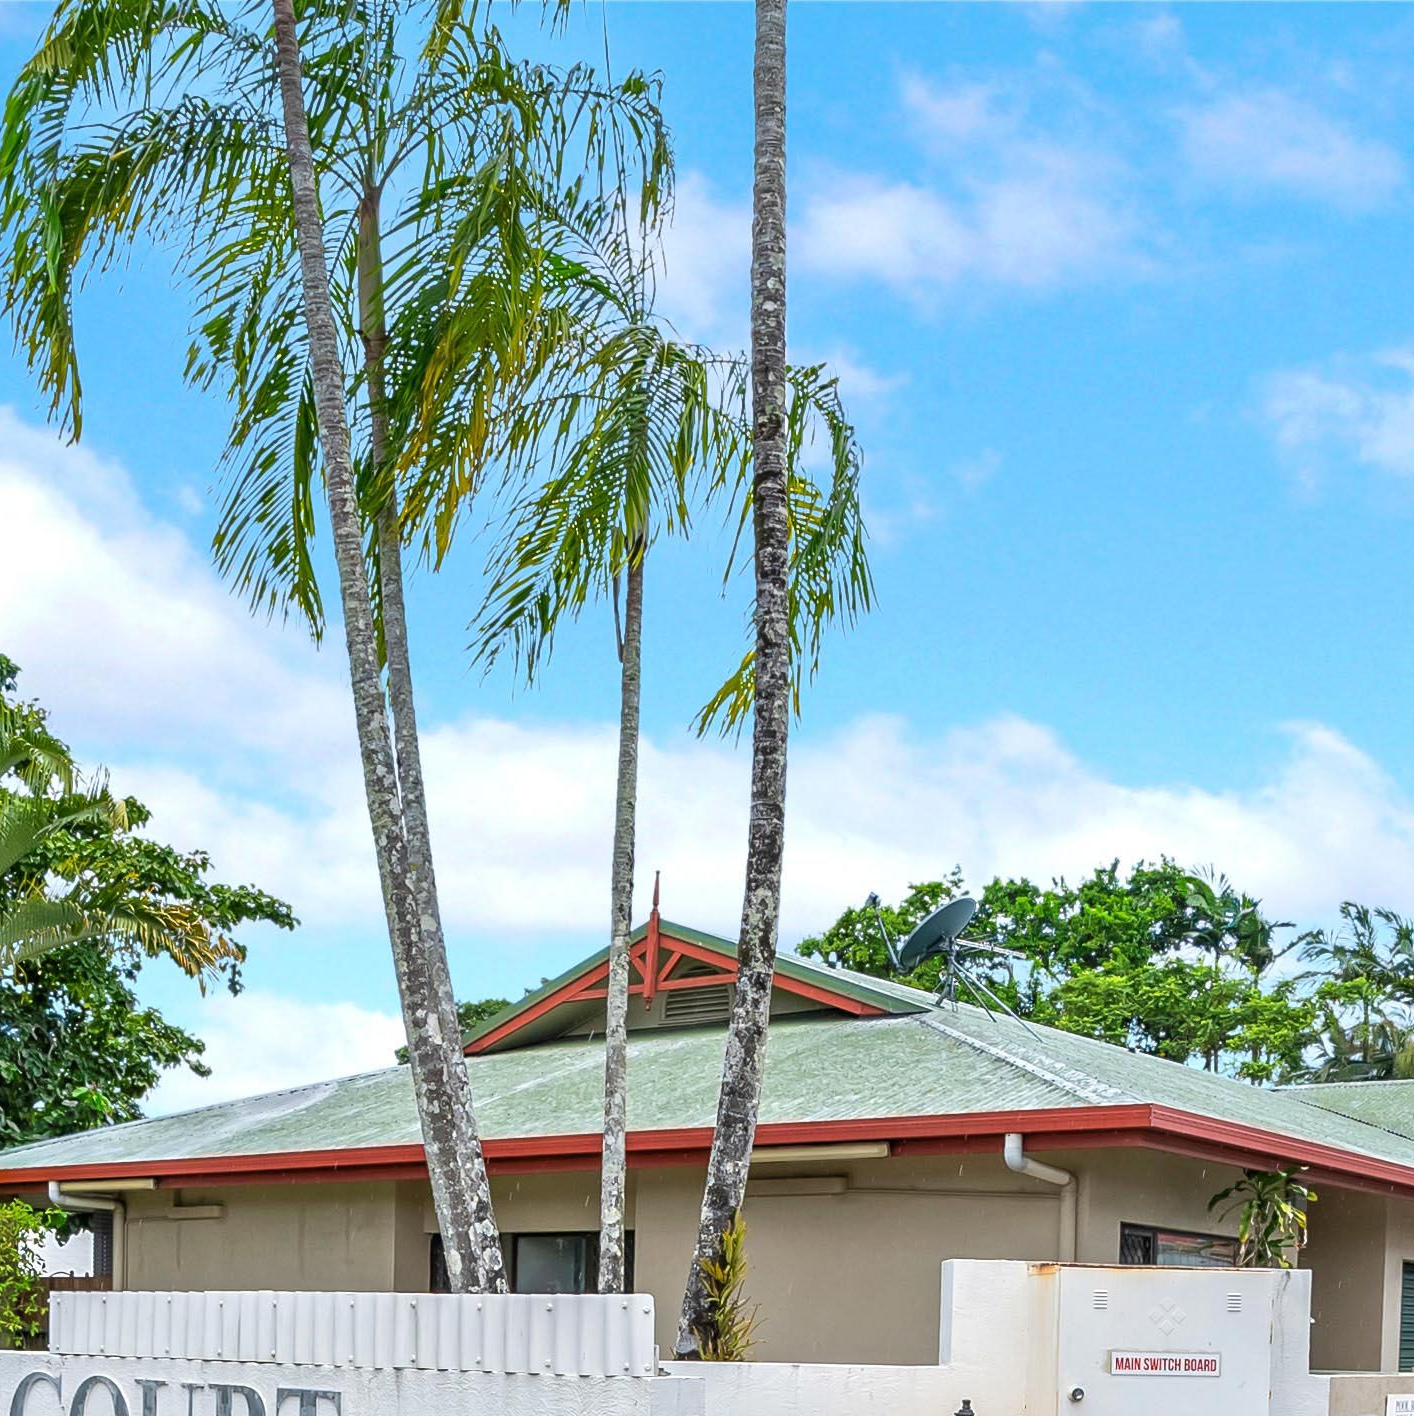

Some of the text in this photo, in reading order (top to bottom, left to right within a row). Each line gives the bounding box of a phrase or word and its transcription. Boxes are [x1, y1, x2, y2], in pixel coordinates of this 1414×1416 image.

[1115, 1357, 1217, 1372] MAIN SWITCH BOARD
